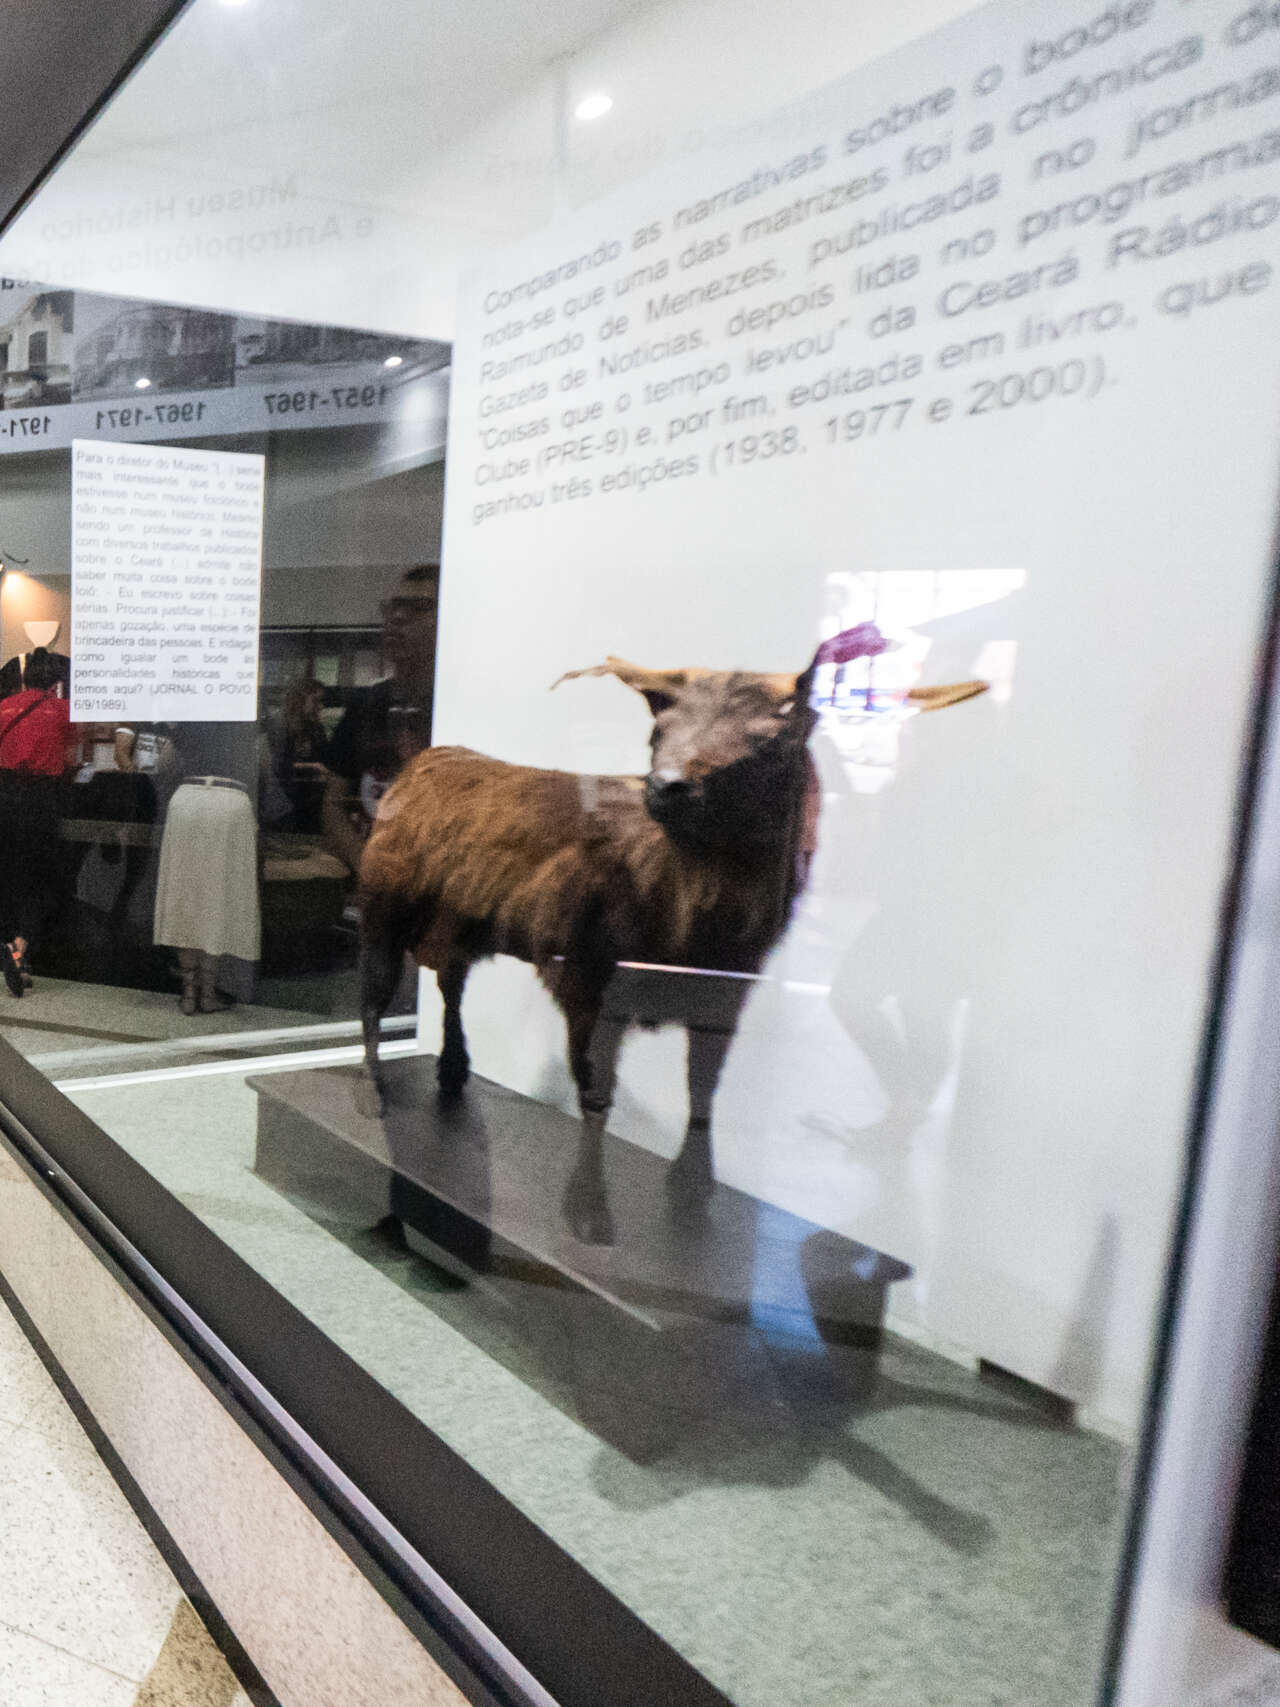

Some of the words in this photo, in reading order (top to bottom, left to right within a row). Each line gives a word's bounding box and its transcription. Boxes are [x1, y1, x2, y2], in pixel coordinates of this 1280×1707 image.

[478, 380, 550, 419] Gazeta
[558, 367, 589, 393] de
[727, 282, 836, 338] depois
[852, 252, 920, 296] lida
[939, 226, 997, 266] no
[1016, 126, 1280, 250] programa
[480, 331, 585, 385] Raimundo
[598, 313, 631, 343] de
[807, 172, 1001, 272] publicada
[1029, 136, 1096, 185] no
[481, 305, 556, 351] nota-se
[562, 285, 607, 320] que
[614, 257, 670, 298] uma
[678, 231, 732, 271] das
[741, 166, 892, 244] matrizes
[902, 128, 953, 180] foi
[967, 121, 996, 154] a
[1008, 33, 1204, 135] crônica
[483, 239, 622, 316] Comparando
[631, 221, 664, 252] as
[673, 144, 829, 231] narrativas
[843, 86, 957, 156] sobre
[972, 64, 1005, 97] o
[1023, 0, 1157, 77] bode
[474, 456, 531, 487] Clube
[535, 426, 630, 478] (PRE-9)
[666, 407, 716, 445] por
[786, 349, 924, 410] editada
[935, 330, 1005, 371] em
[1152, 259, 1274, 318] que
[561, 399, 604, 432] que
[613, 391, 633, 414] o
[642, 361, 732, 406] tempo
[867, 303, 917, 340] da
[936, 247, 1081, 320] Ceará
[1104, 193, 1280, 272] Rádio
[472, 488, 546, 527] ganhou
[550, 475, 594, 505] três
[599, 454, 700, 495] edições
[825, 397, 915, 444] 1977
[925, 396, 955, 424] e
